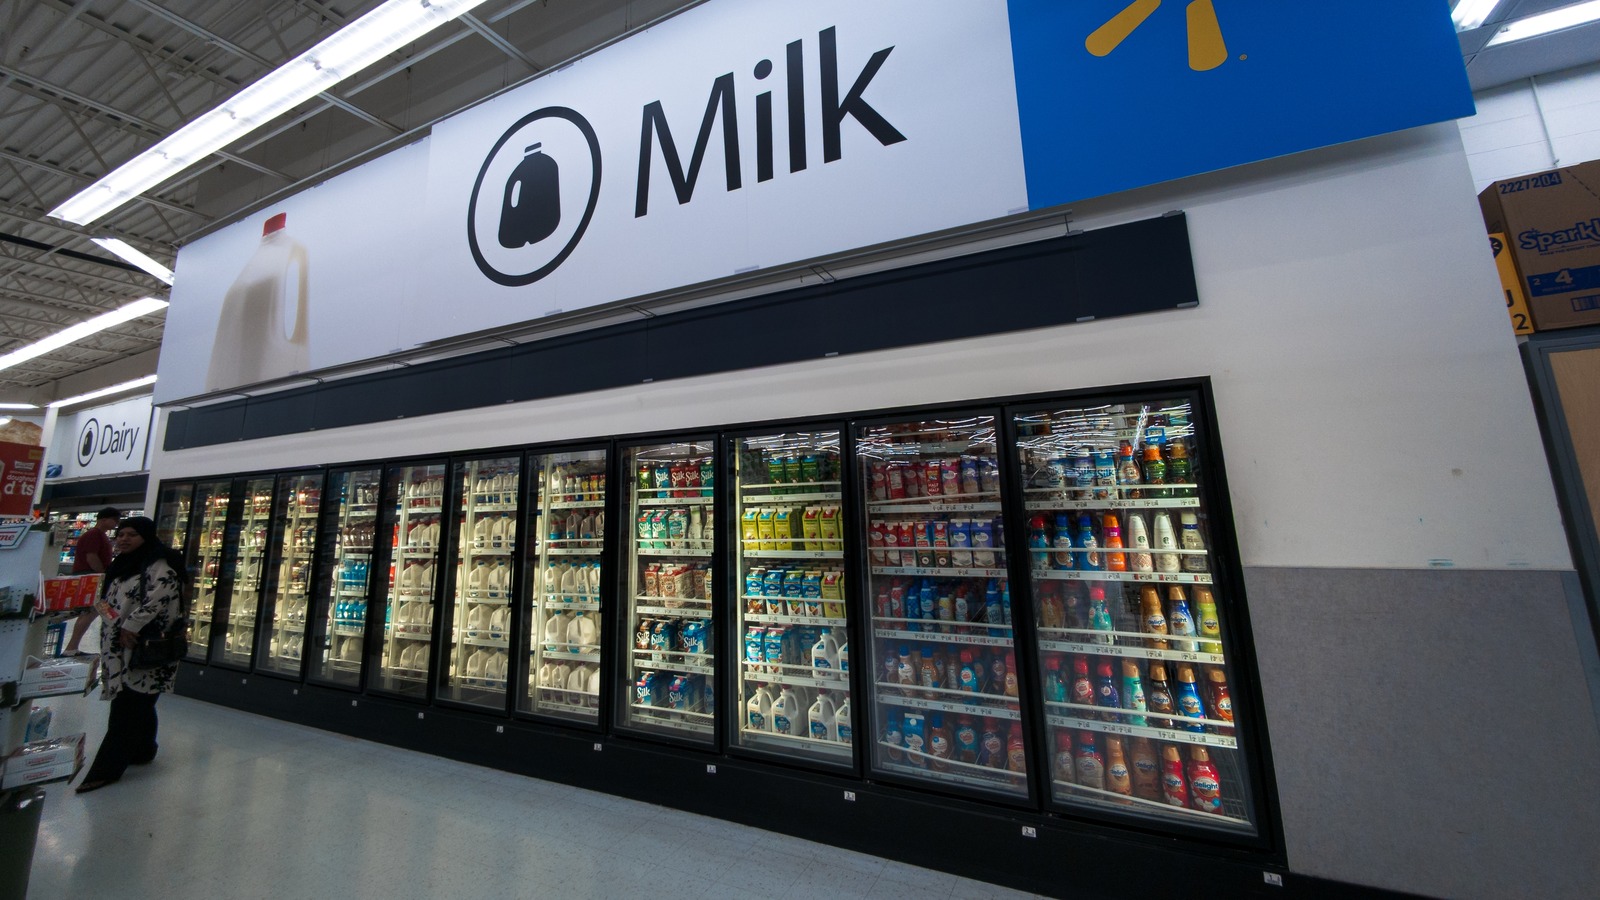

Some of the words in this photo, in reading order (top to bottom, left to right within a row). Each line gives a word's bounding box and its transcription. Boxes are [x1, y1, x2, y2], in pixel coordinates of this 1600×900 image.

[635, 25, 907, 218] Milk
[1555, 267, 1574, 285] 4
[1513, 313, 1529, 331] 2
[100, 421, 140, 460] Dairy
[655, 471, 669, 482] Silk
[671, 470, 685, 482] Silk
[685, 470, 700, 482] Silk
[700, 470, 714, 482] Silk
[638, 521, 651, 534] Silk
[652, 521, 665, 534] Silk
[636, 631, 650, 643] Silk
[651, 633, 665, 645] Silk
[683, 636, 698, 648] Silk
[637, 687, 651, 699] Silk
[669, 691, 683, 703] Silk
[1193, 782, 1219, 791] delight
